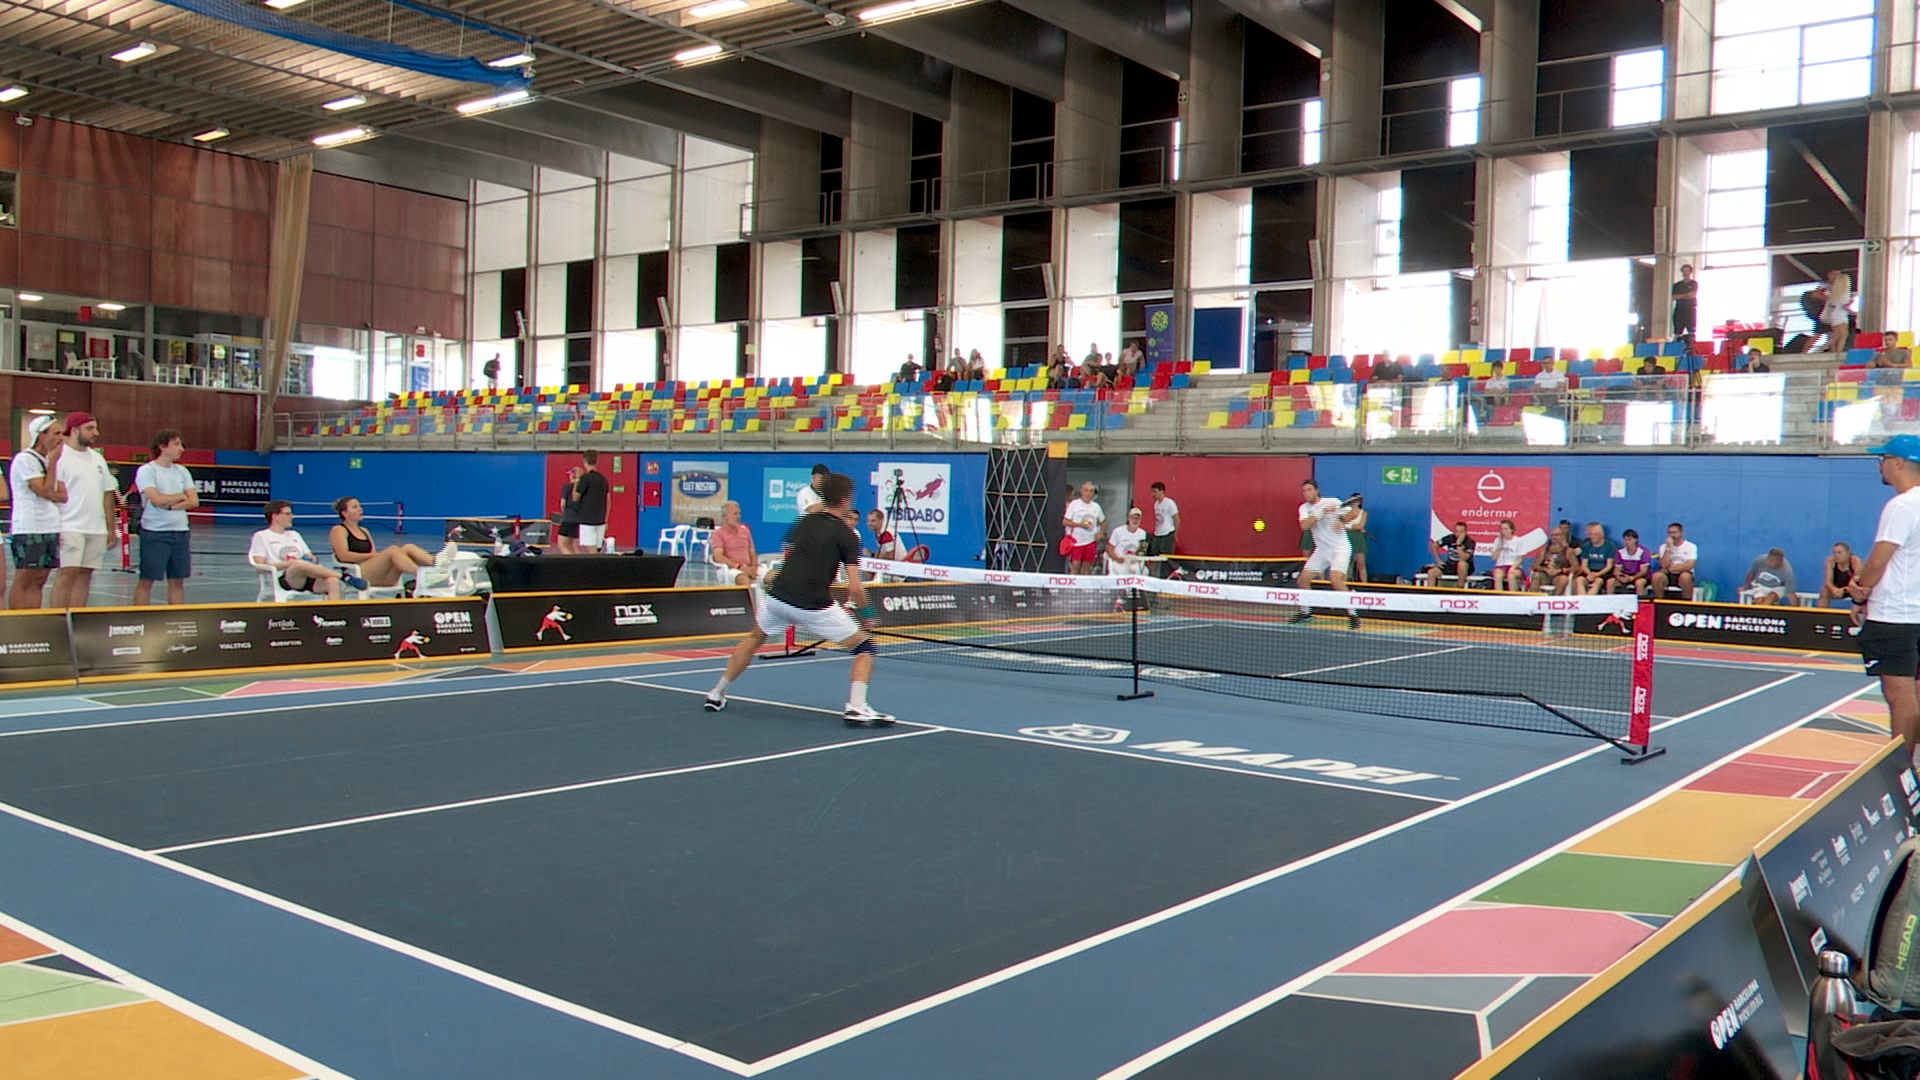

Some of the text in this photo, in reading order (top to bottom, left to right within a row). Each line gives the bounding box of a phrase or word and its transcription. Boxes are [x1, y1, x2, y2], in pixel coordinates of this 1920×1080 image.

[194, 480, 216, 493] EN
[221, 480, 269, 488] BARCELONA
[682, 481, 717, 492] LLET NOSTRA
[884, 506, 945, 523] TIBIDABO
[1461, 505, 1518, 518] endermar
[1195, 569, 1228, 581] OPEN
[883, 595, 919, 612] OPEN
[918, 594, 956, 603] BARCELONA
[434, 611, 471, 624] OPEN
[1668, 612, 1722, 629] OPEN
[1724, 615, 1786, 627] BARCELONA
[1126, 740, 1442, 785] MAPEI
[1895, 914, 1917, 970] HEAD
[1710, 1004, 1741, 1051] OPEN
